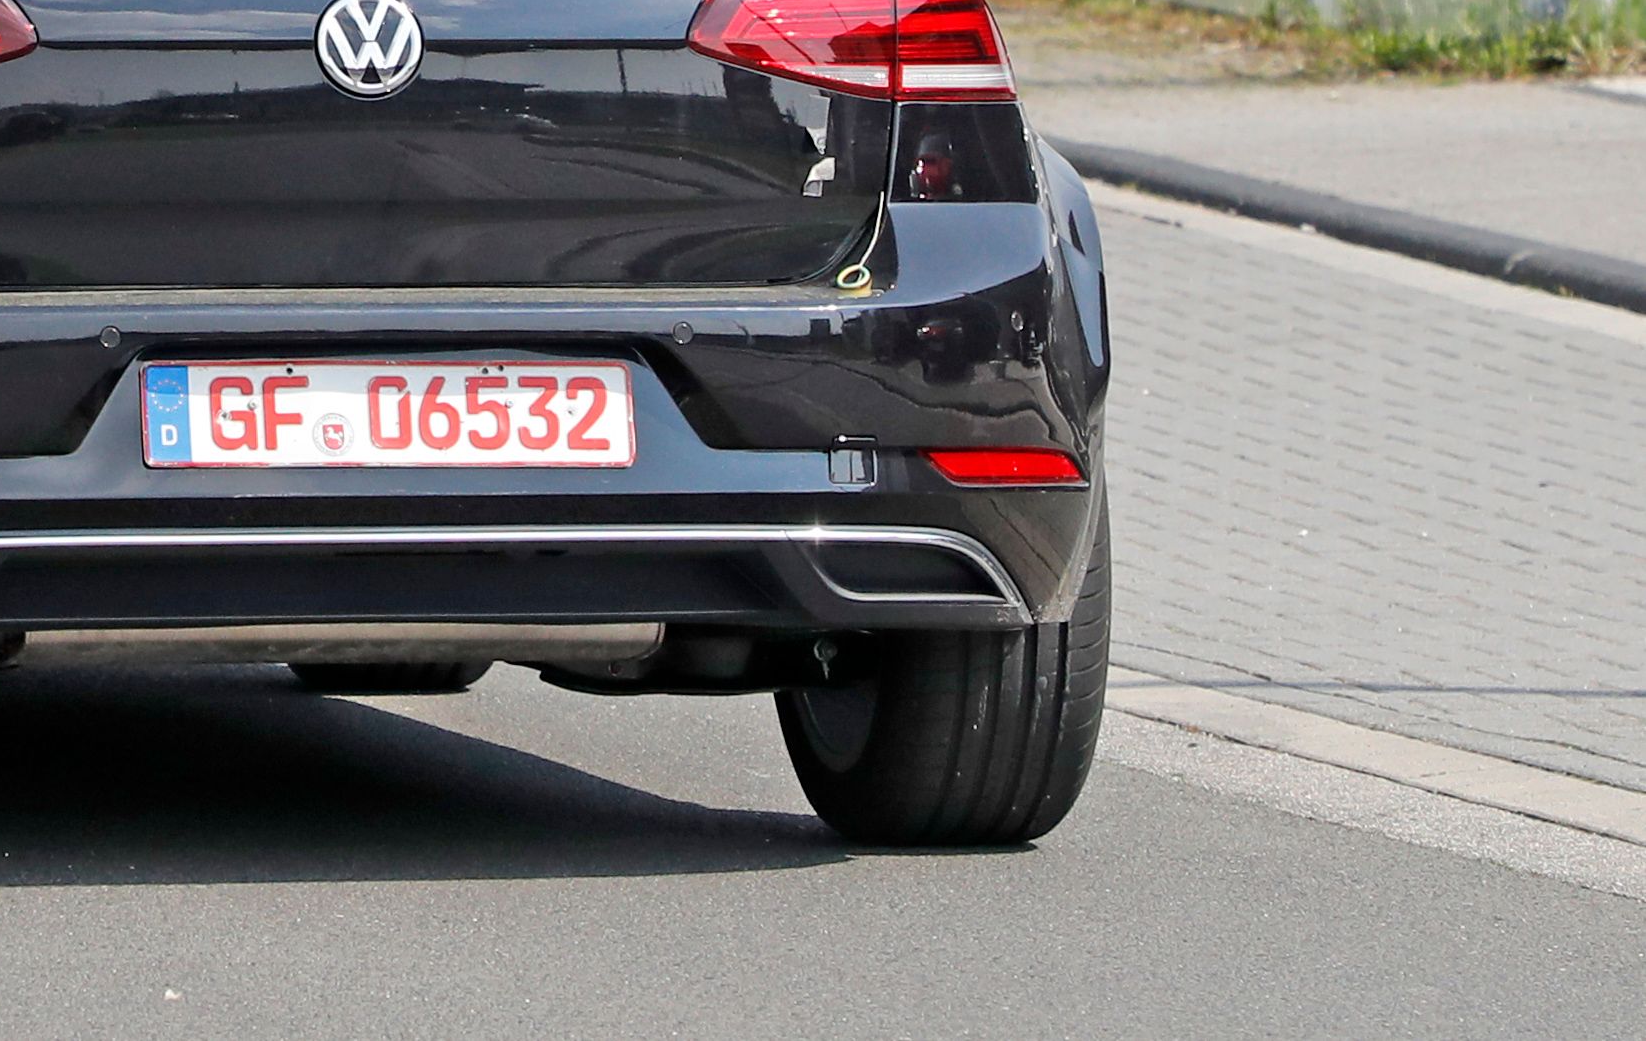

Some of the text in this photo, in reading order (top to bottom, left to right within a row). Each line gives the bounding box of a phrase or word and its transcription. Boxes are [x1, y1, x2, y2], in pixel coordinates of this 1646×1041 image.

[160, 423, 179, 447] D
[209, 375, 310, 450] GF
[367, 375, 611, 451] 06532
